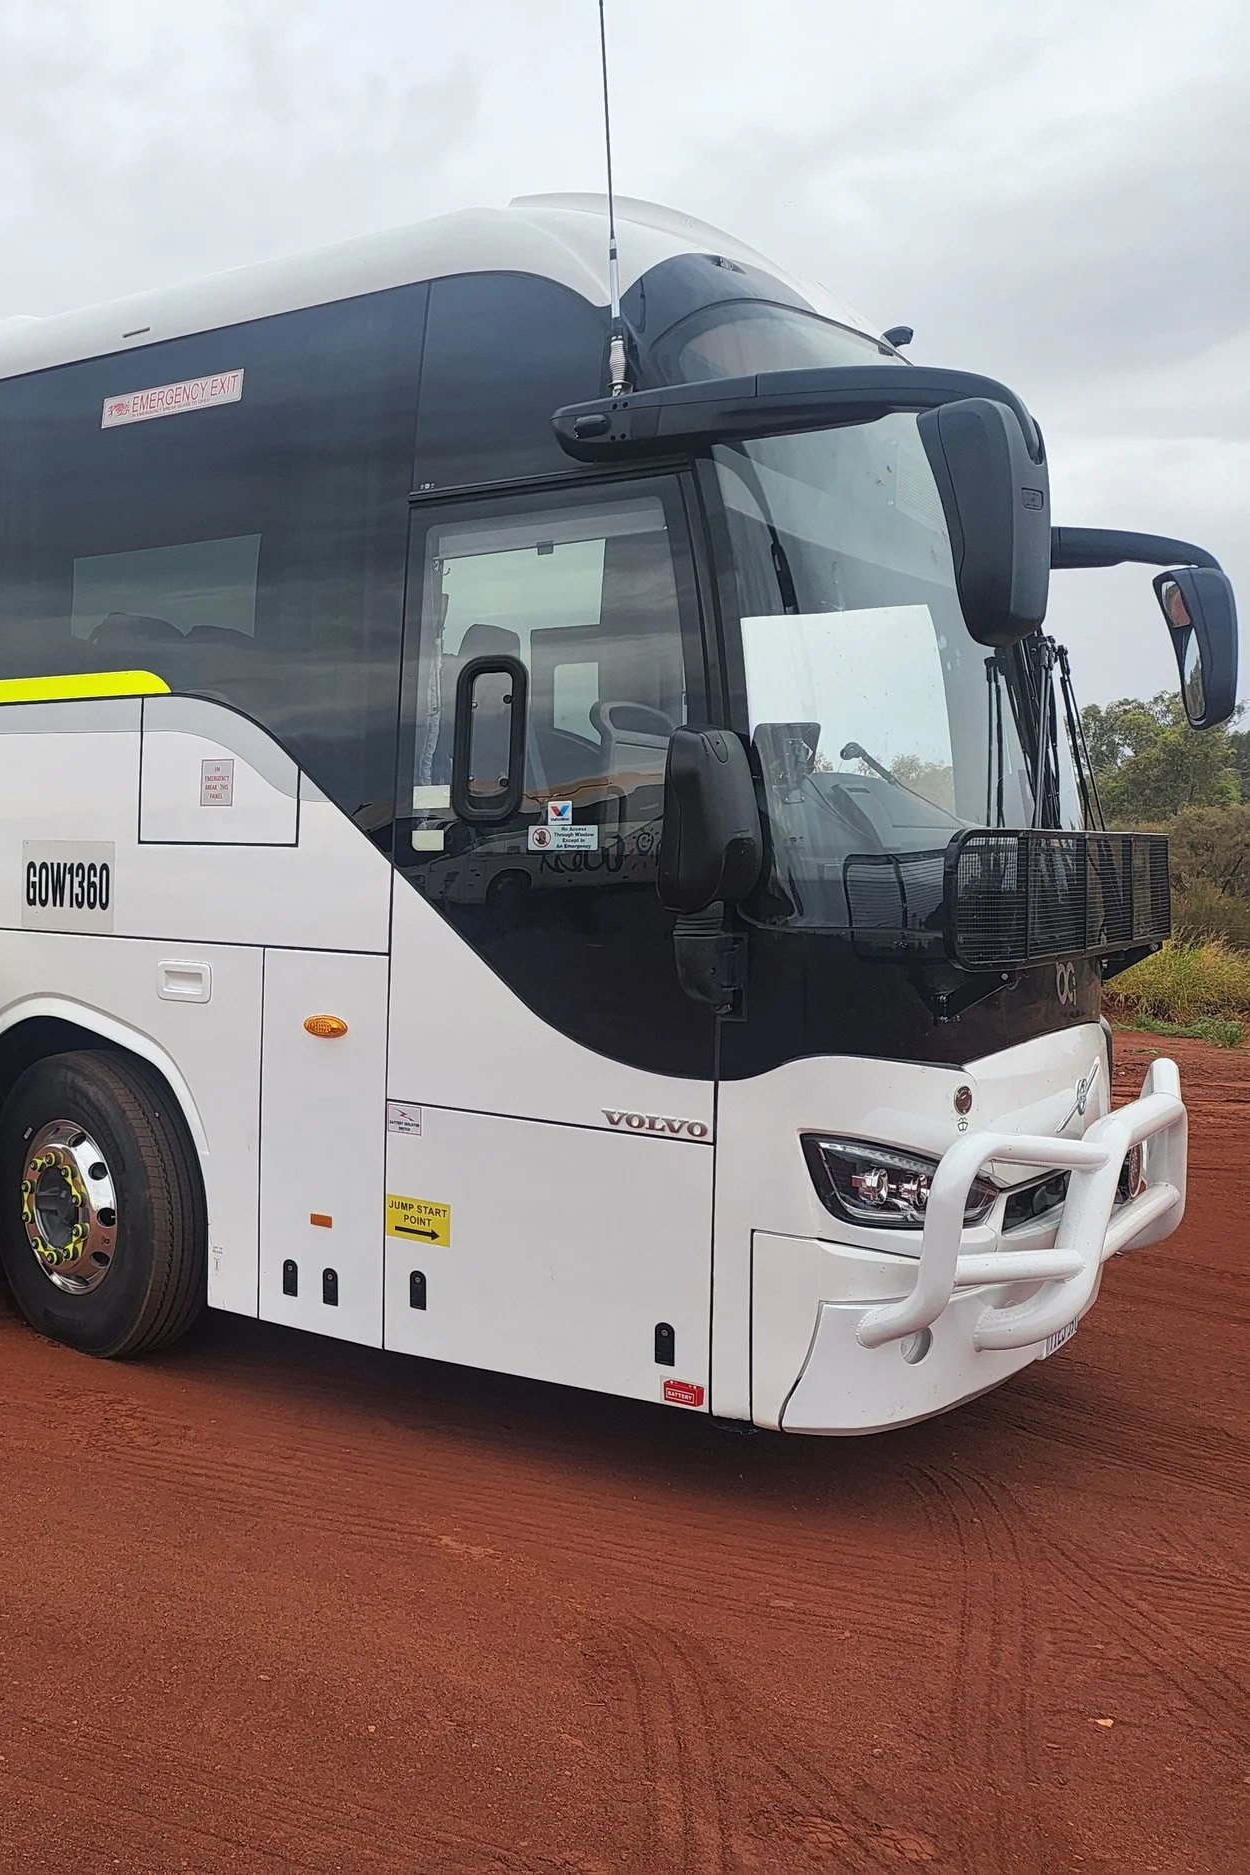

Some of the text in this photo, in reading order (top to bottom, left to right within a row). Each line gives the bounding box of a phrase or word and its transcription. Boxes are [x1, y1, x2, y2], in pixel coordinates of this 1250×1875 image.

[132, 374, 239, 413] EMERGENCY EXIT
[136, 408, 163, 418] EMERGENCY
[163, 404, 176, 412] BREAK
[209, 792, 223, 800] PANEL
[26, 860, 111, 911] GOW1360
[600, 1109, 708, 1138] VOLVO
[388, 1199, 448, 1219] JUMP START
[403, 1214, 433, 1228] POINT
[667, 1390, 693, 1401] BATTERY
